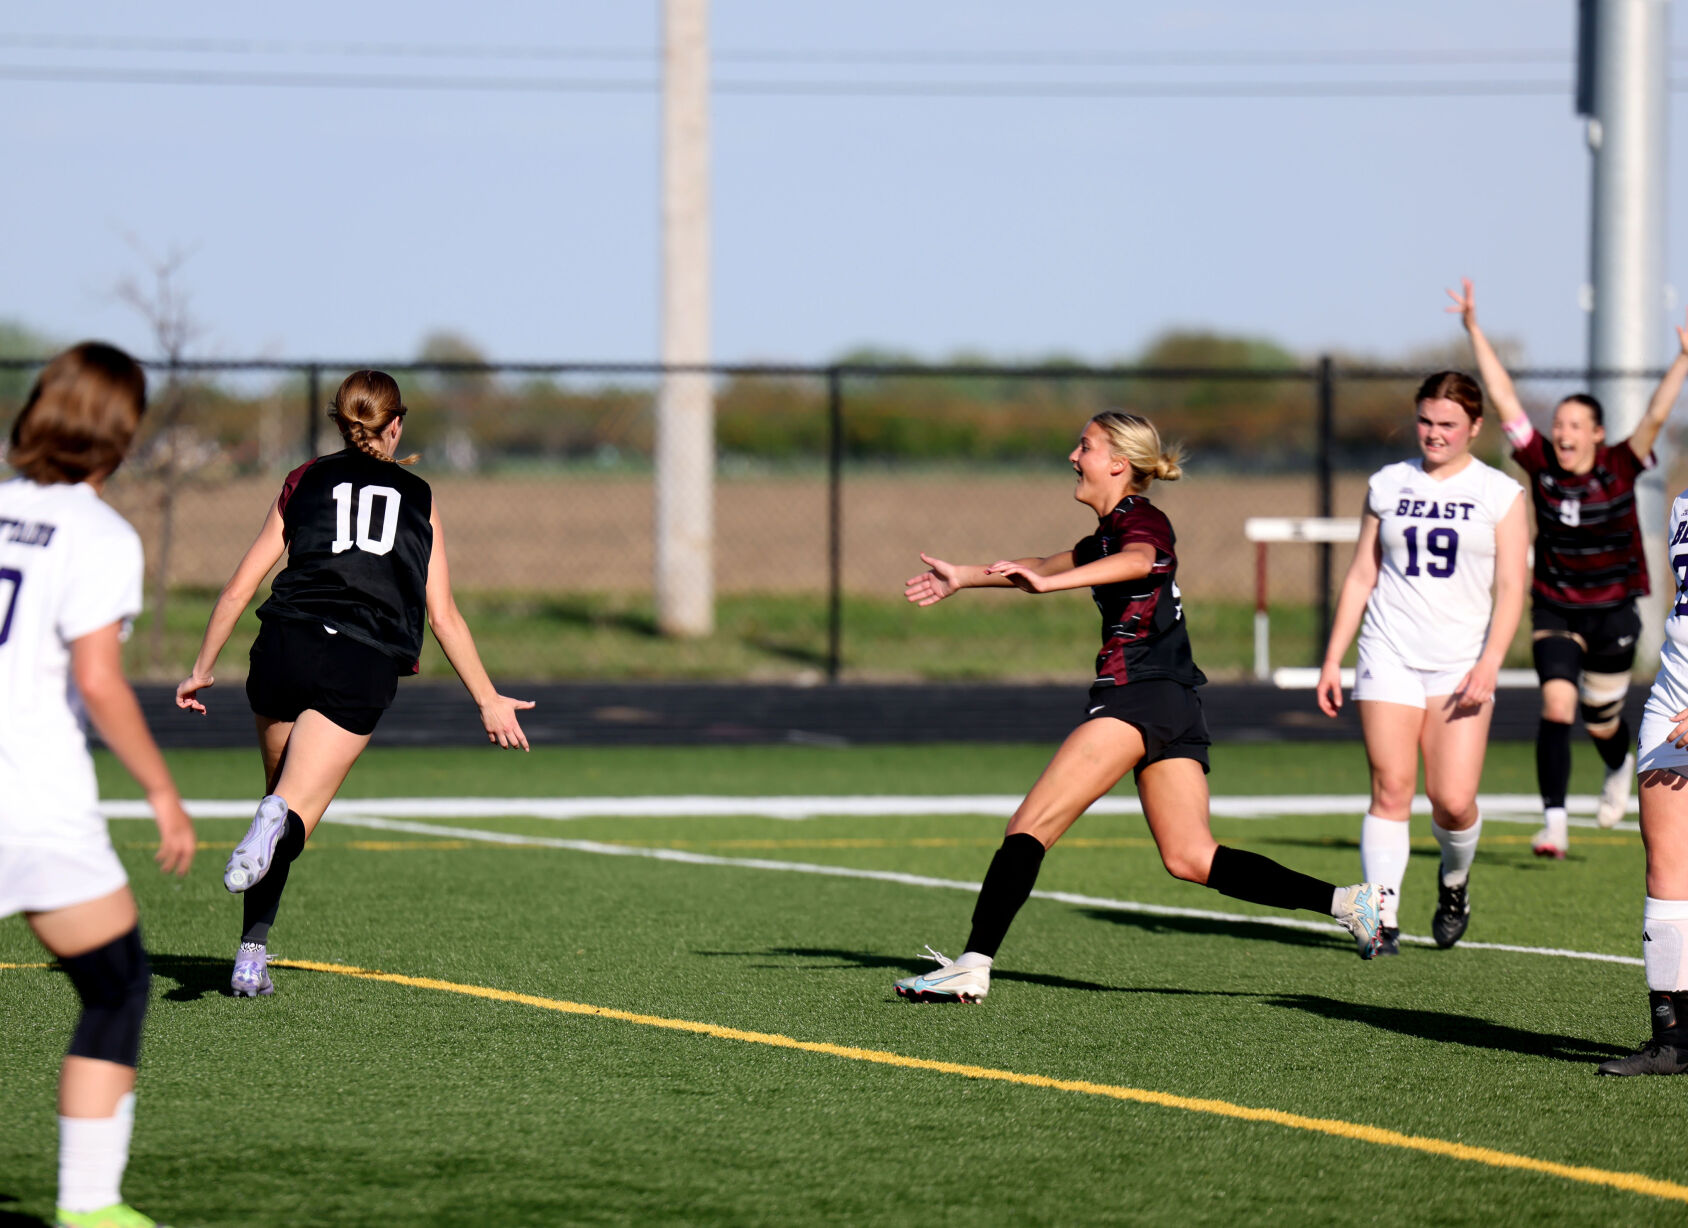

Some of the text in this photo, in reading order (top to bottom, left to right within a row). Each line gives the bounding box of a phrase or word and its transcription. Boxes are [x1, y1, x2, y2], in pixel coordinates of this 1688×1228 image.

[332, 482, 402, 556] 10
[1395, 498, 1475, 520] BEAST
[1403, 526, 1459, 578] 19
